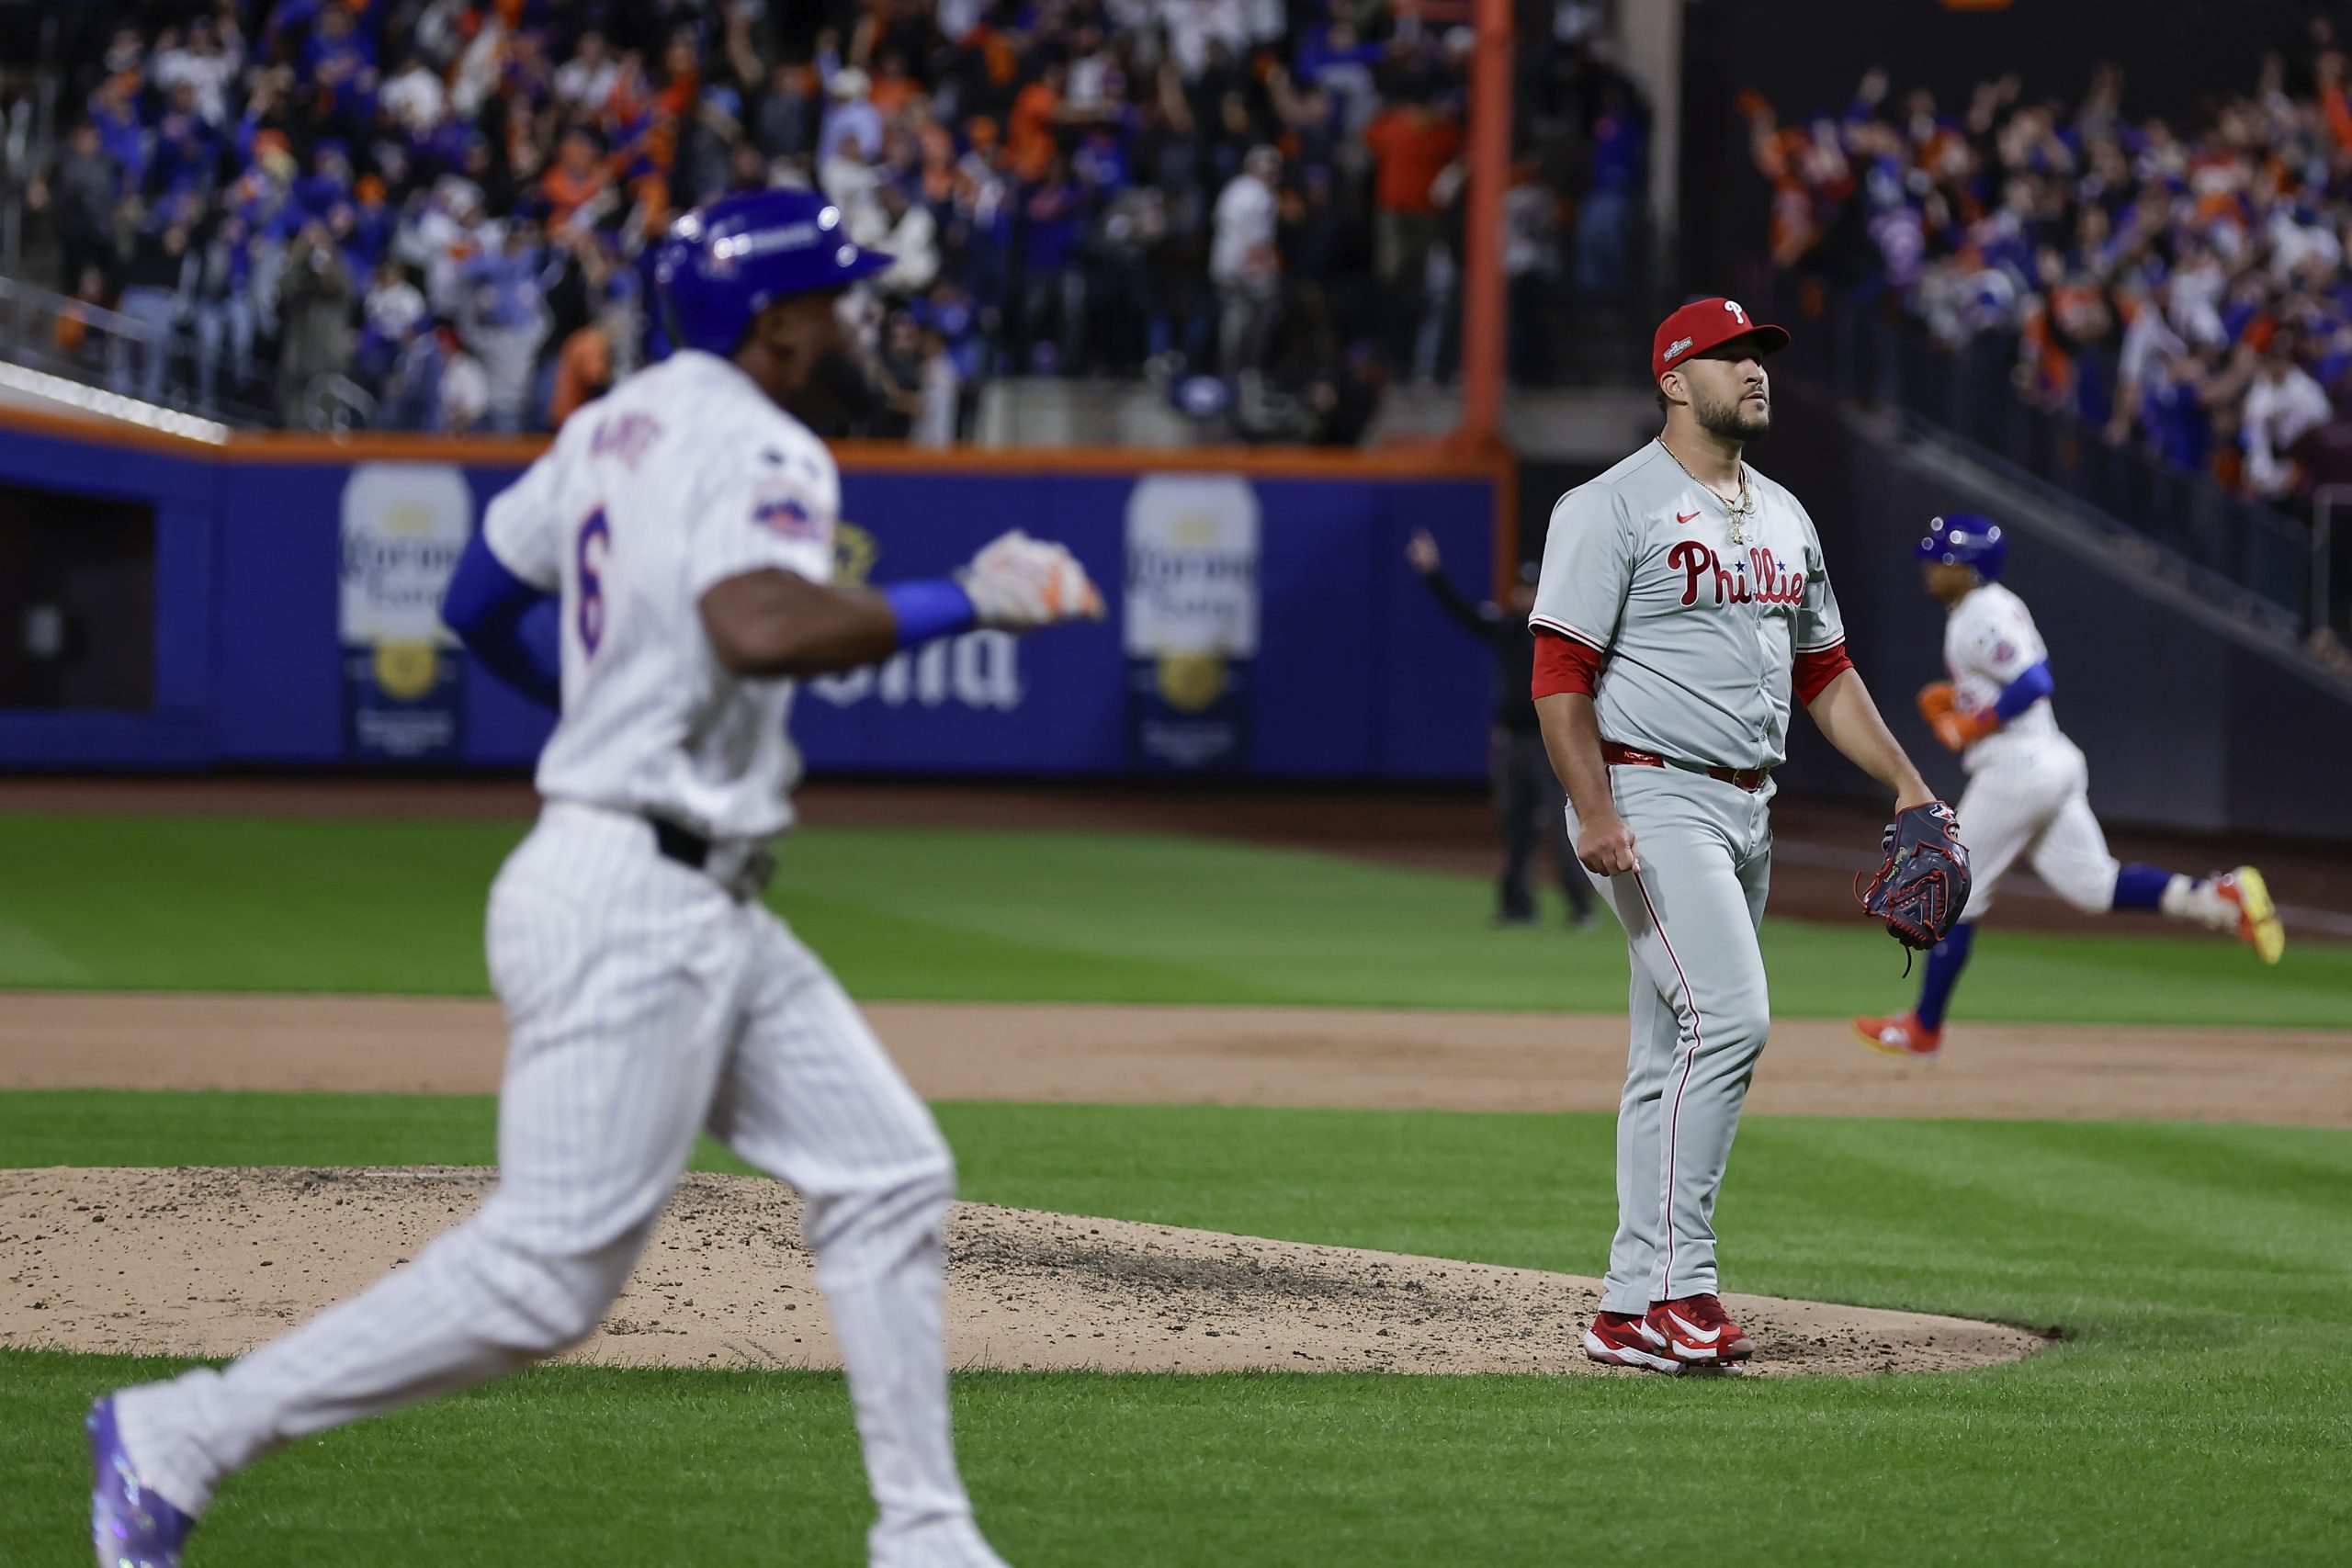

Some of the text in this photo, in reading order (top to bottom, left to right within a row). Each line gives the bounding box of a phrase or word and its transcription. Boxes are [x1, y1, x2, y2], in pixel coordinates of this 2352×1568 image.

[1724, 300, 1745, 324] P
[576, 502, 610, 667] 6
[1667, 540, 1806, 606] Phillie
